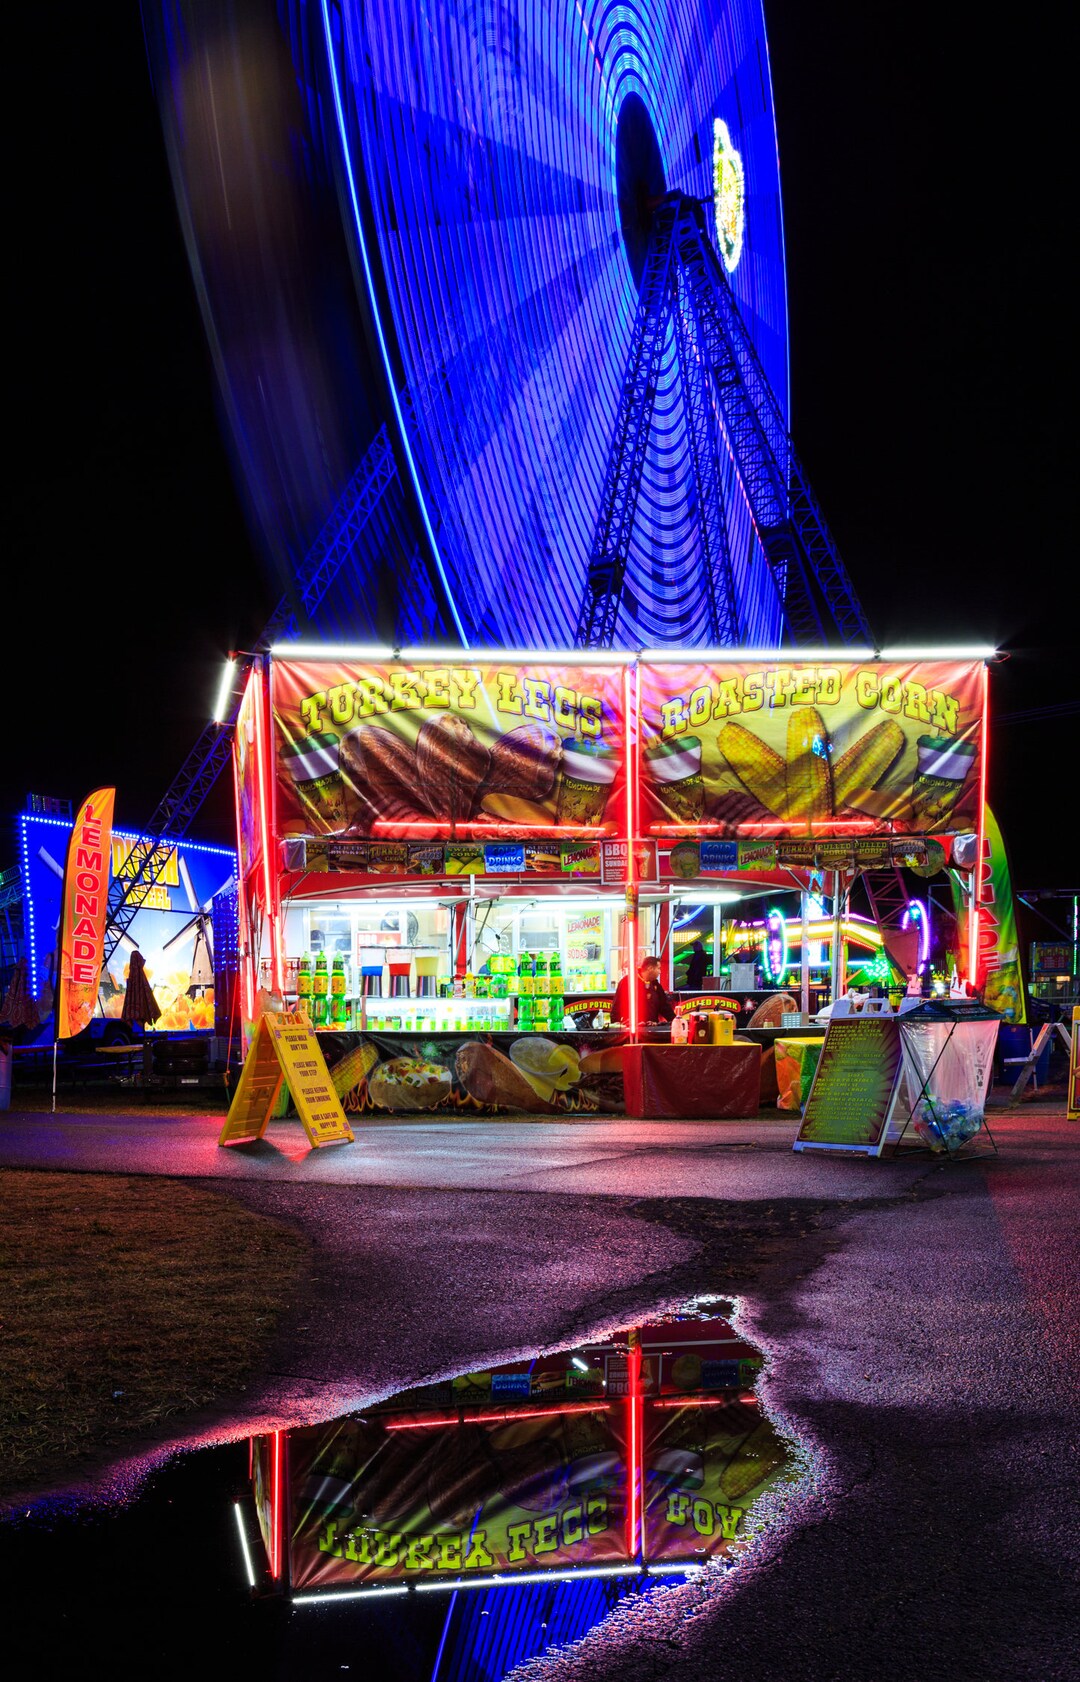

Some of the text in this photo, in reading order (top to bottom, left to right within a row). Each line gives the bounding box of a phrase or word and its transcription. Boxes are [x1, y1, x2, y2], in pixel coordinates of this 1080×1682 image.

[301, 669, 604, 738] TURKEY LEGS
[660, 667, 960, 740] ROASTED CORN
[566, 779, 600, 792] LEMONADE
[493, 846, 518, 855] COLD
[605, 843, 628, 857] BBQ
[706, 843, 732, 851] COLD
[818, 842, 852, 851] PULLED
[854, 841, 888, 849] PULLED
[370, 847, 406, 858] TURKEY
[563, 845, 598, 867] LEMONADE
[703, 853, 736, 863] DRINKS
[740, 843, 775, 866] LEMONADE
[488, 856, 523, 867] DRINKS
[72, 804, 104, 985] LEMONADE
[568, 915, 601, 933] LEMONADE
[568, 949, 588, 960] SODAS
[564, 1001, 588, 1015] BAKED
